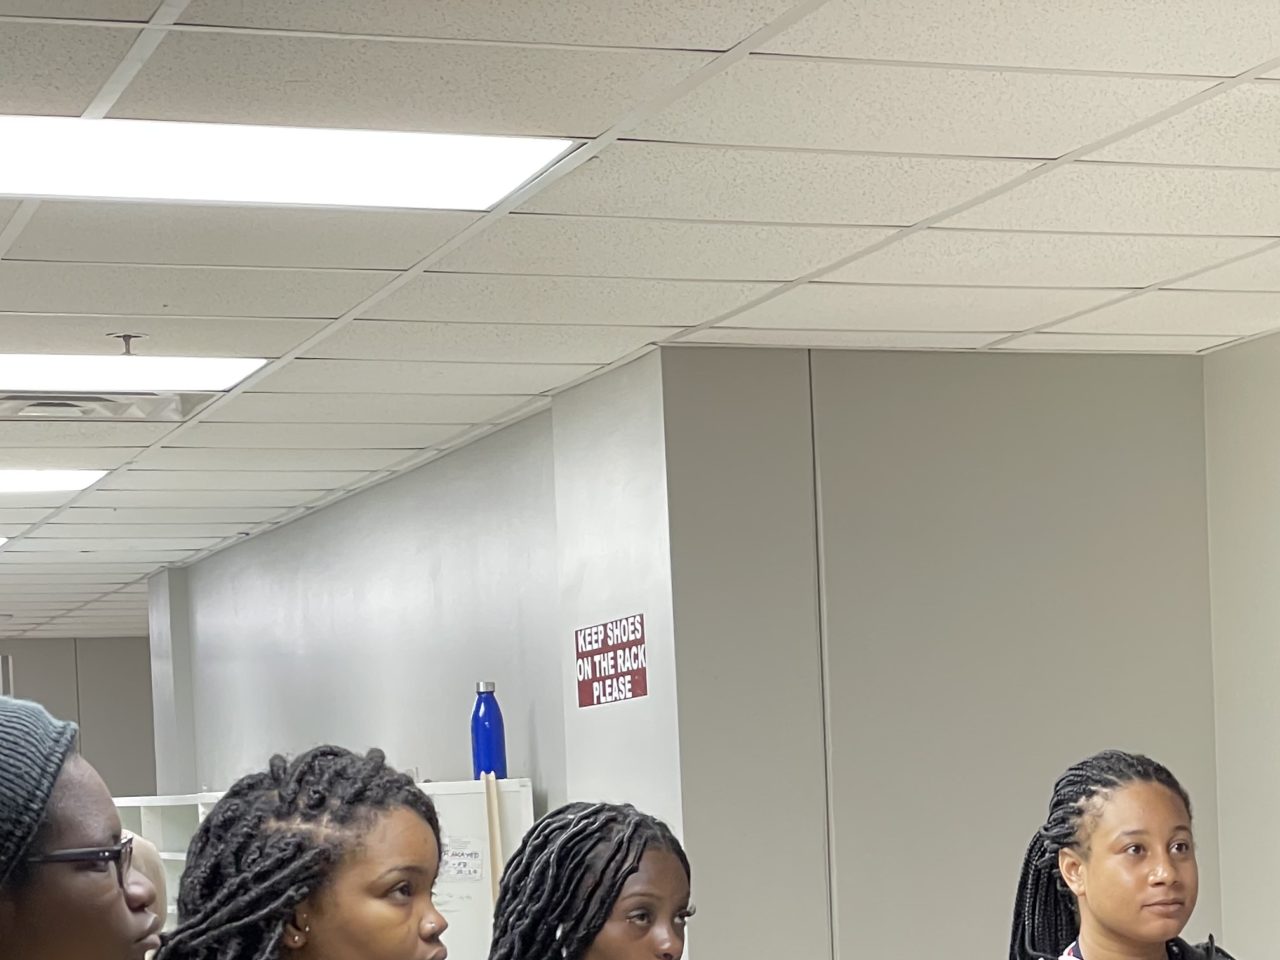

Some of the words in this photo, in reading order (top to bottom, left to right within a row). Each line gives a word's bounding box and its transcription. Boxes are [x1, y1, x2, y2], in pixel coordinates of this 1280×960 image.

[578, 625, 605, 652] KEEP
[607, 616, 641, 645] SHOES
[577, 656, 592, 681] ON
[594, 651, 615, 677] THE
[616, 644, 647, 672] RACK
[593, 675, 632, 704] PLEASE
